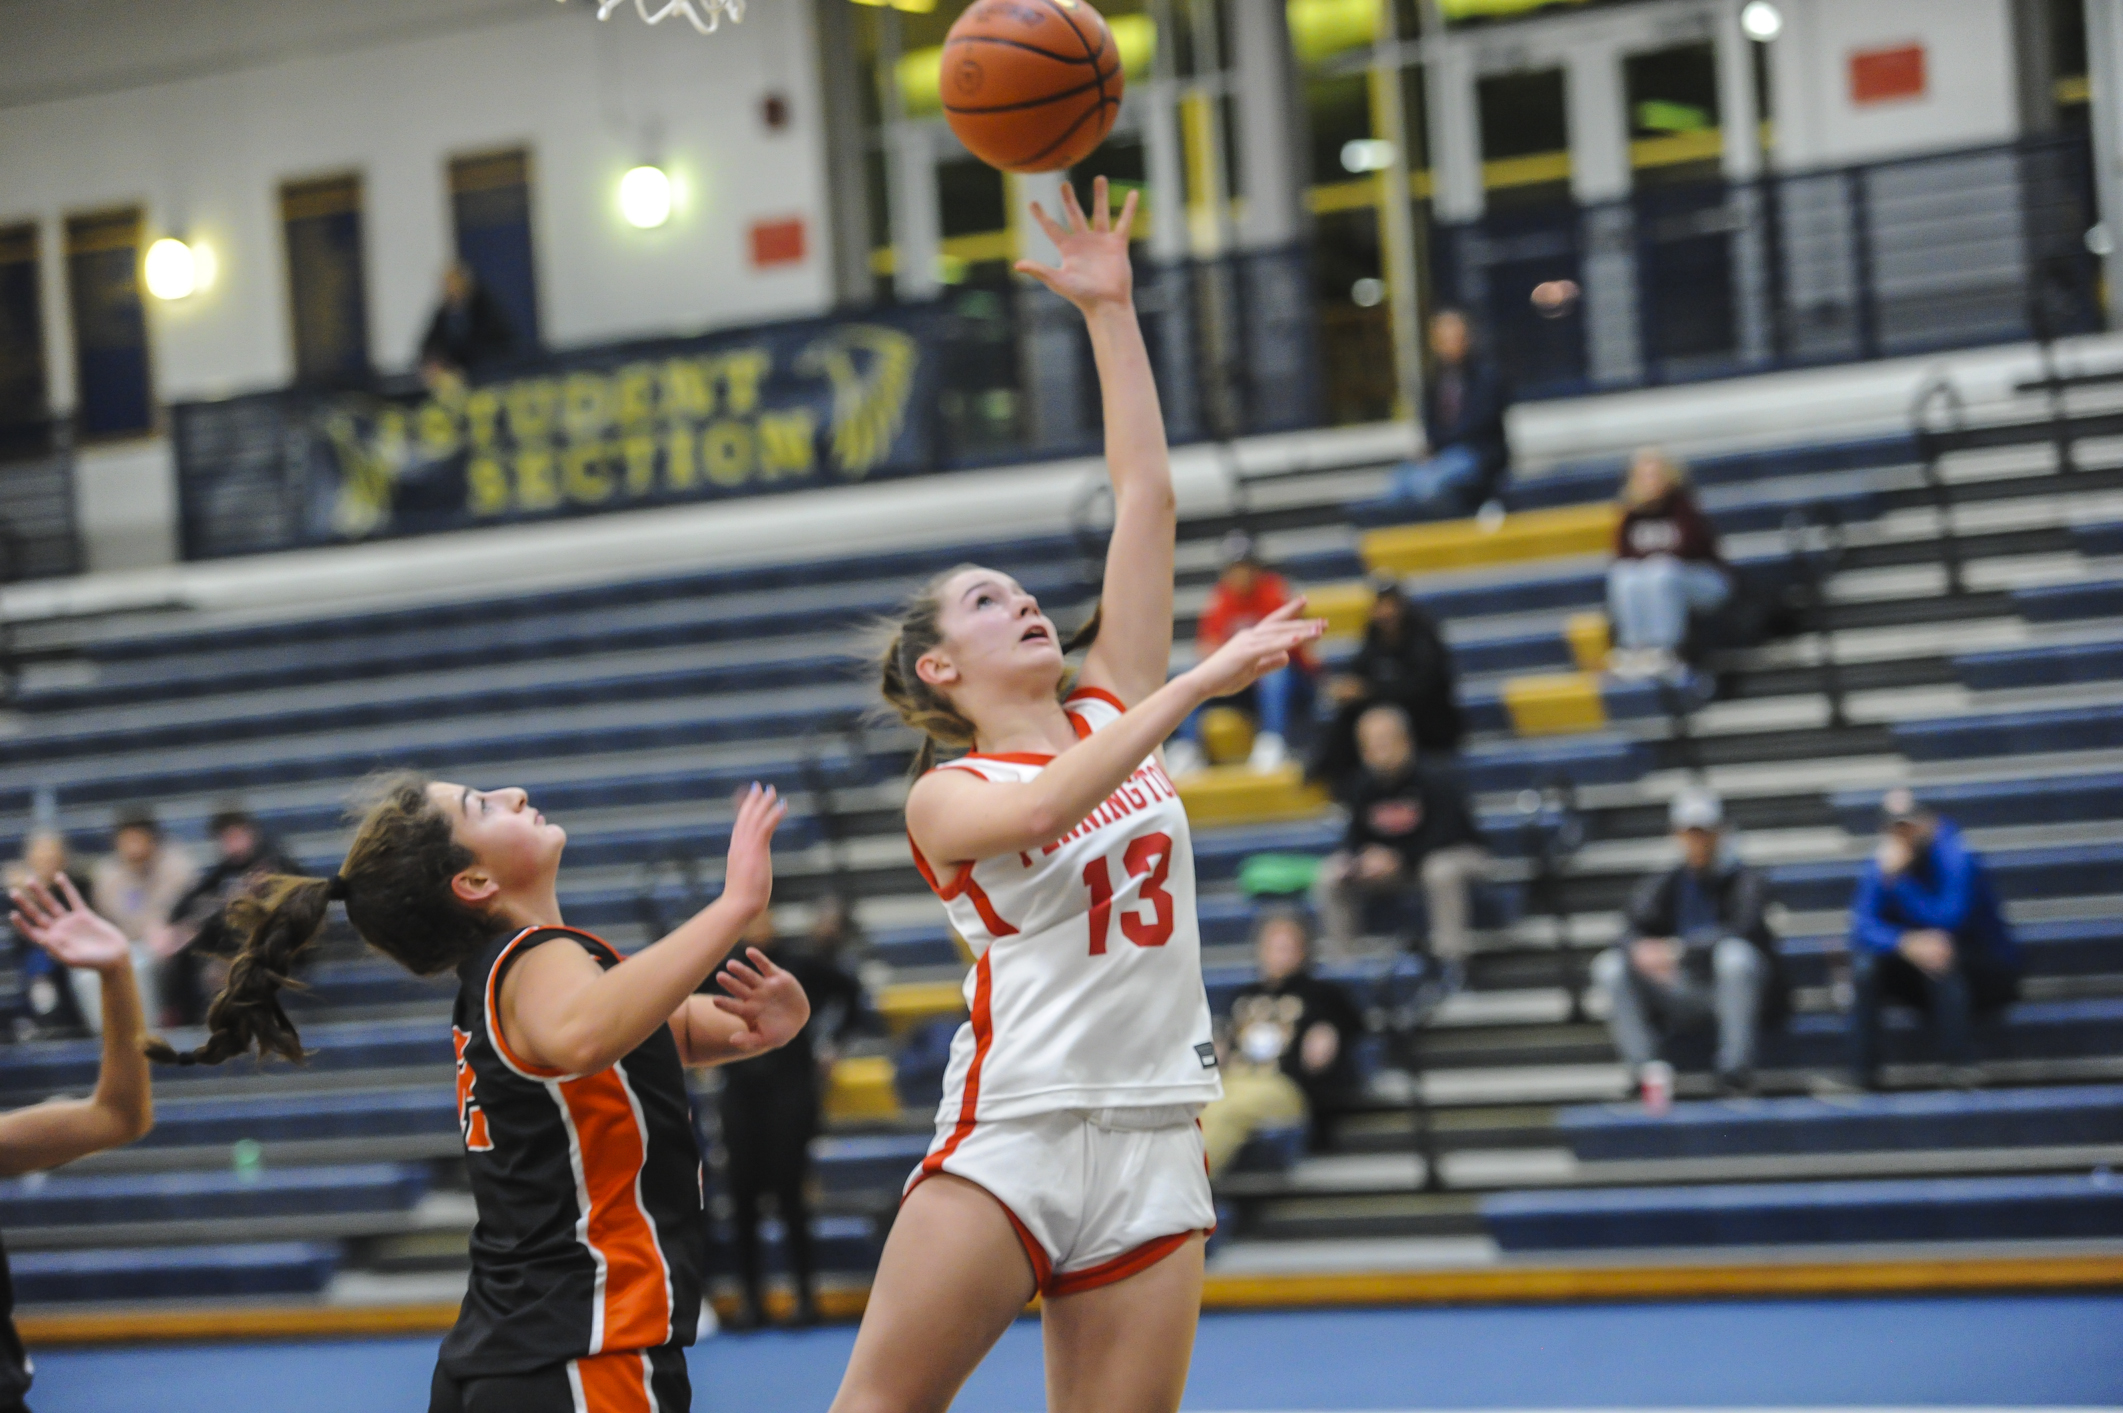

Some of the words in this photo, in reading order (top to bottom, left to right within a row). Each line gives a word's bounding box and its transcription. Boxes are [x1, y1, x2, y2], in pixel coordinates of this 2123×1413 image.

[416, 349, 771, 449] STUDENT
[468, 411, 815, 515] SECTION
[1082, 831, 1175, 956] 13
